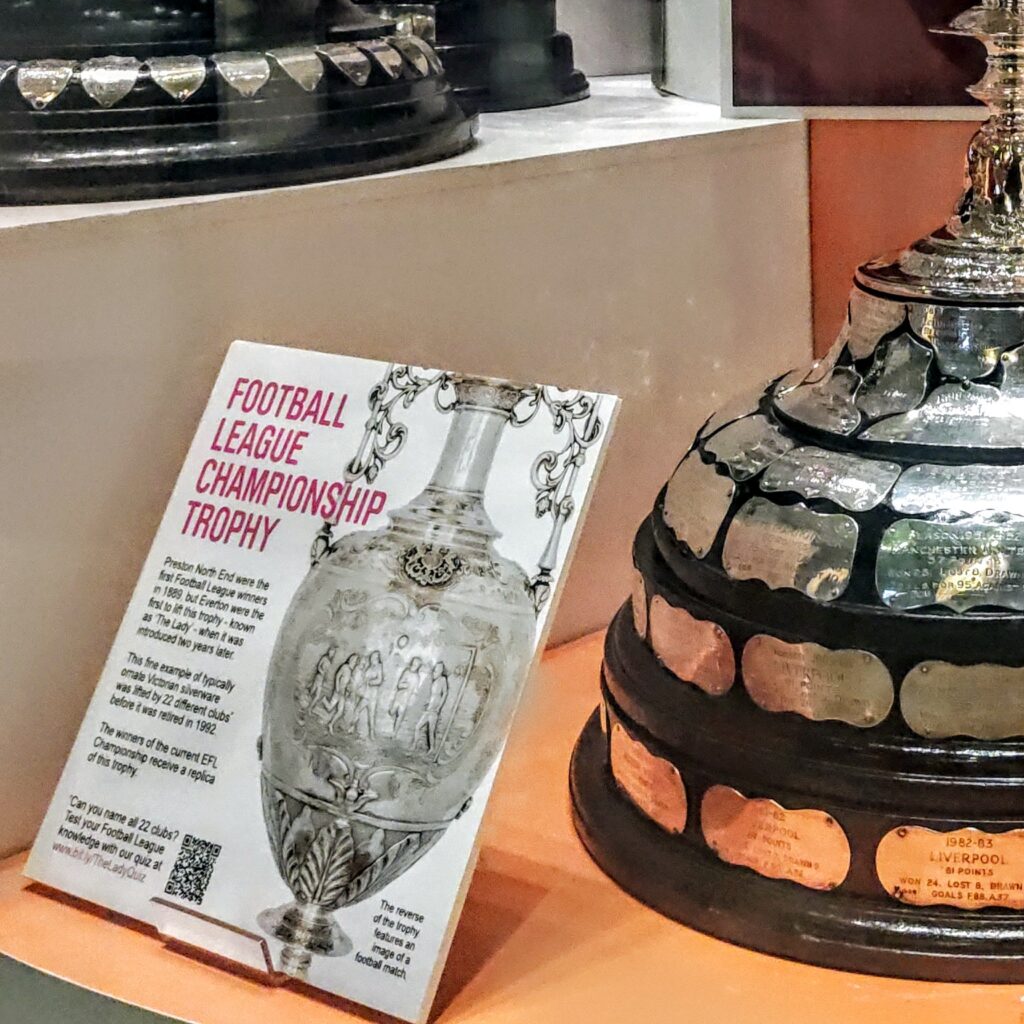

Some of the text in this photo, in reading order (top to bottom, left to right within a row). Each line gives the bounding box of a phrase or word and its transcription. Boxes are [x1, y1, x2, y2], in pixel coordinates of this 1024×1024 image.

[227, 377, 348, 429] FOOTBALL
[210, 417, 309, 465] LEAGUE
[196, 458, 387, 526] CHAMPIONSHIP
[181, 500, 281, 552] TROPHY
[158, 570, 268, 605] first Football League winners
[164, 557, 269, 590] Preston North End were the
[148, 597, 164, 609] first
[164, 602, 172, 612] to
[172, 604, 183, 615] lift
[183, 607, 197, 618] this
[199, 611, 223, 627] trophy
[229, 618, 256, 634] known
[153, 585, 161, 593] in
[185, 592, 198, 604] but
[198, 595, 229, 612] Everton
[230, 604, 250, 616] were
[251, 608, 265, 620] the
[137, 626, 177, 644] introduced
[178, 636, 192, 648] two
[192, 640, 214, 654] years
[142, 612, 152, 622] as
[198, 627, 220, 640] when
[220, 631, 226, 641] it
[227, 635, 244, 647] was
[120, 667, 221, 704] ornate Victorian silverware
[127, 651, 235, 694] This fine example of typically
[109, 694, 136, 711] before
[135, 702, 141, 713] it
[142, 705, 158, 717] was
[158, 710, 185, 726] retired
[185, 717, 194, 727] in
[115, 682, 132, 694] was
[132, 685, 151, 700] lifted
[151, 692, 162, 704] by
[161, 694, 174, 706] 22
[173, 699, 208, 717] different
[87, 751, 98, 763] of
[96, 754, 111, 768] this
[93, 736, 216, 785] Championship receive a replica
[99, 721, 218, 769] The winners of the current EFL
[64, 810, 165, 855] Test your Football League
[87, 804, 102, 817] you
[104, 810, 126, 824] name
[127, 816, 139, 828] all
[138, 819, 152, 832] 22
[151, 824, 180, 842] clubs?
[58, 824, 164, 871] knowledge with our quiz at
[929, 851, 1008, 865] LIVERPOOL
[946, 837, 993, 848] 1982-83
[899, 877, 921, 885] WON
[947, 880, 972, 888] LOST
[990, 882, 1022, 890] DRAWN
[945, 866, 994, 876] 81 POINTS
[381, 899, 425, 923] The reverse
[931, 890, 963, 899] GOALS
[373, 914, 420, 939] of the trophy
[374, 928, 415, 951] features an
[354, 952, 383, 970] football
[371, 942, 411, 965] image of a
